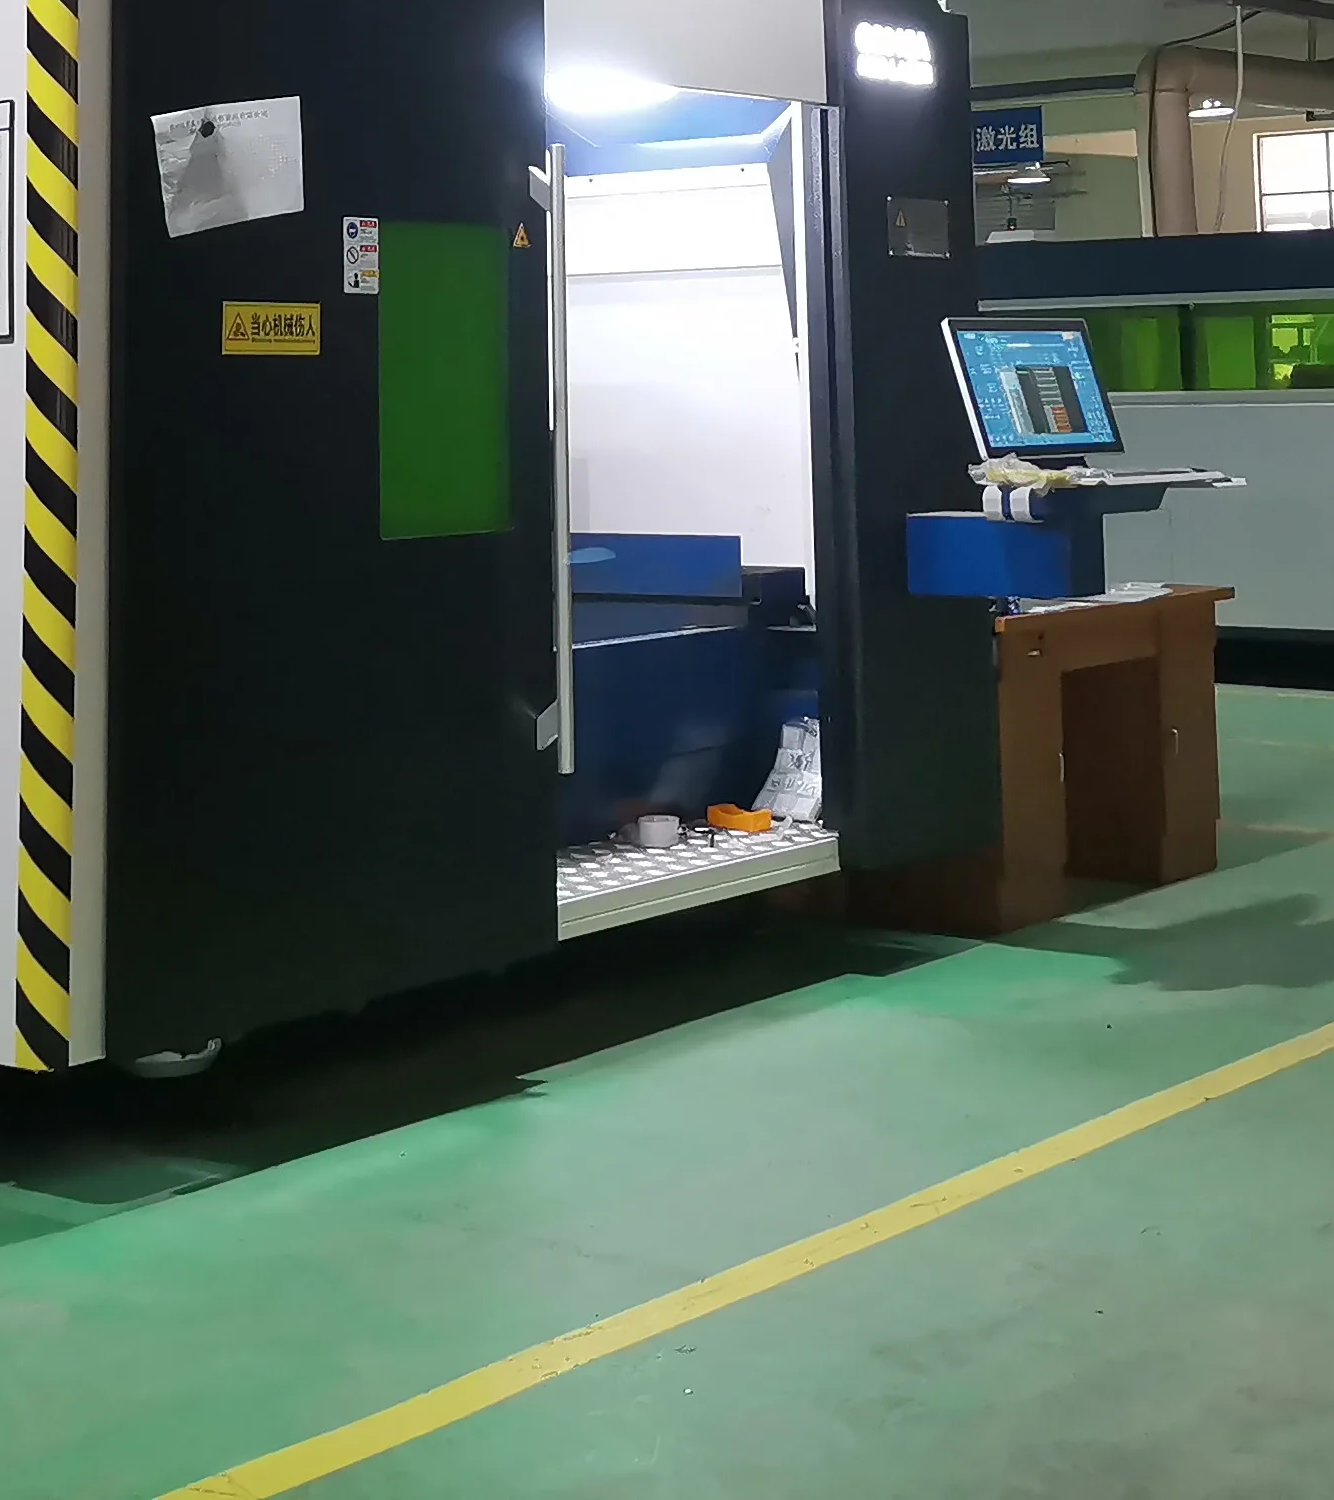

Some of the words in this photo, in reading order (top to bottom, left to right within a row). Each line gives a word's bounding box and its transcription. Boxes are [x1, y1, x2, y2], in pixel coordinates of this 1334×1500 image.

[975, 123, 1040, 152] 激光组
[250, 312, 316, 337] 当心机械伤人
